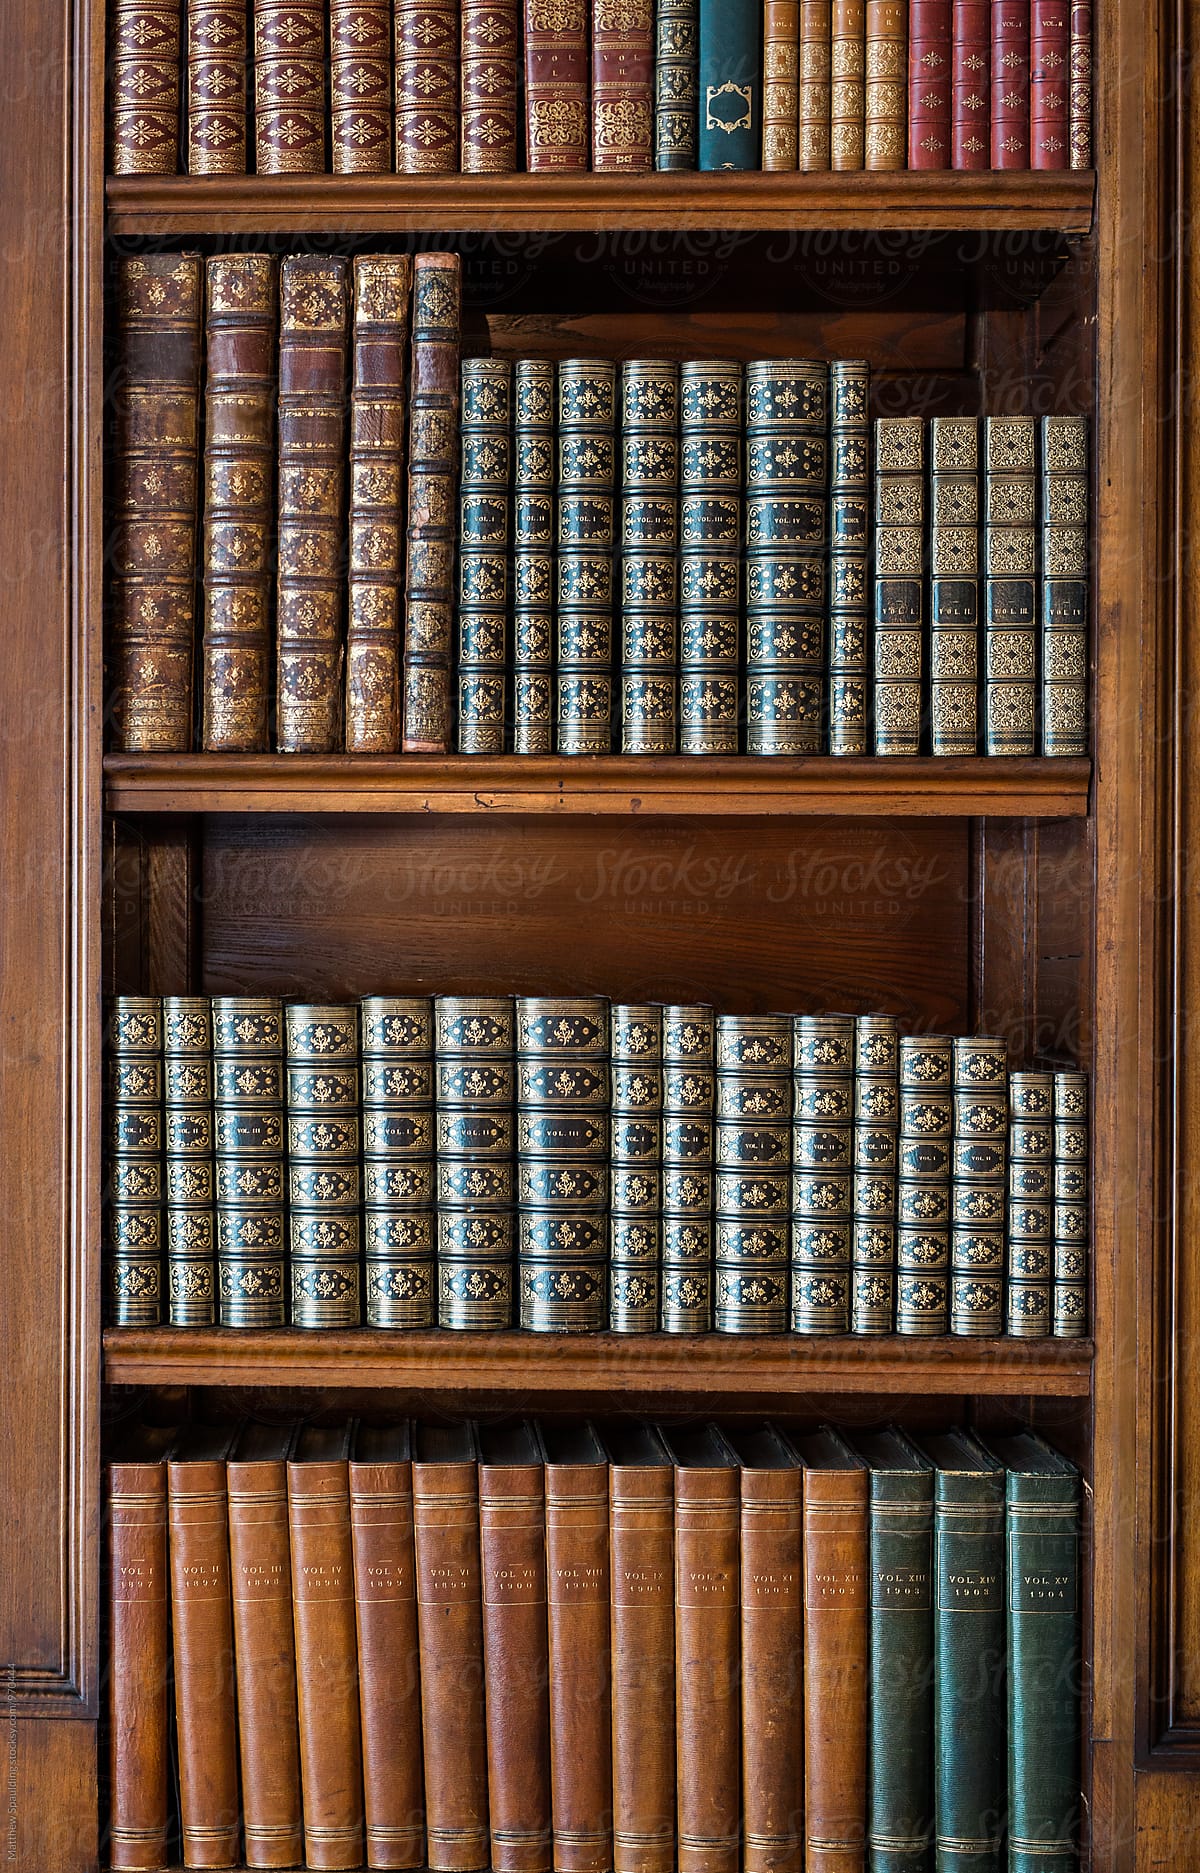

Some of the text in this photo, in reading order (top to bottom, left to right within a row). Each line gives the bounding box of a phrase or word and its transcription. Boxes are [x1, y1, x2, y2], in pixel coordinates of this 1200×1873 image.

[271, 1565, 282, 1573] III
[331, 1566, 342, 1574] IV
[653, 1572, 664, 1580] IX
[845, 1574, 859, 1582] XII
[908, 1574, 926, 1582] XIII
[979, 1576, 996, 1584] XIV
[1055, 1576, 1069, 1584] XV
[121, 1580, 153, 1588] 1897
[186, 1578, 218, 1588] 1897
[248, 1578, 279, 1587] 1898
[308, 1579, 340, 1587] 1898
[370, 1580, 402, 1588] 1899
[434, 1581, 467, 1589] 1899
[499, 1582, 532, 1590] 1900
[694, 1585, 726, 1593] 1901
[755, 1587, 789, 1595] 1902
[822, 1587, 855, 1595] 1902
[886, 1587, 920, 1595] 1903
[955, 1588, 989, 1596] 1903
[1030, 1590, 1064, 1598] 1904
